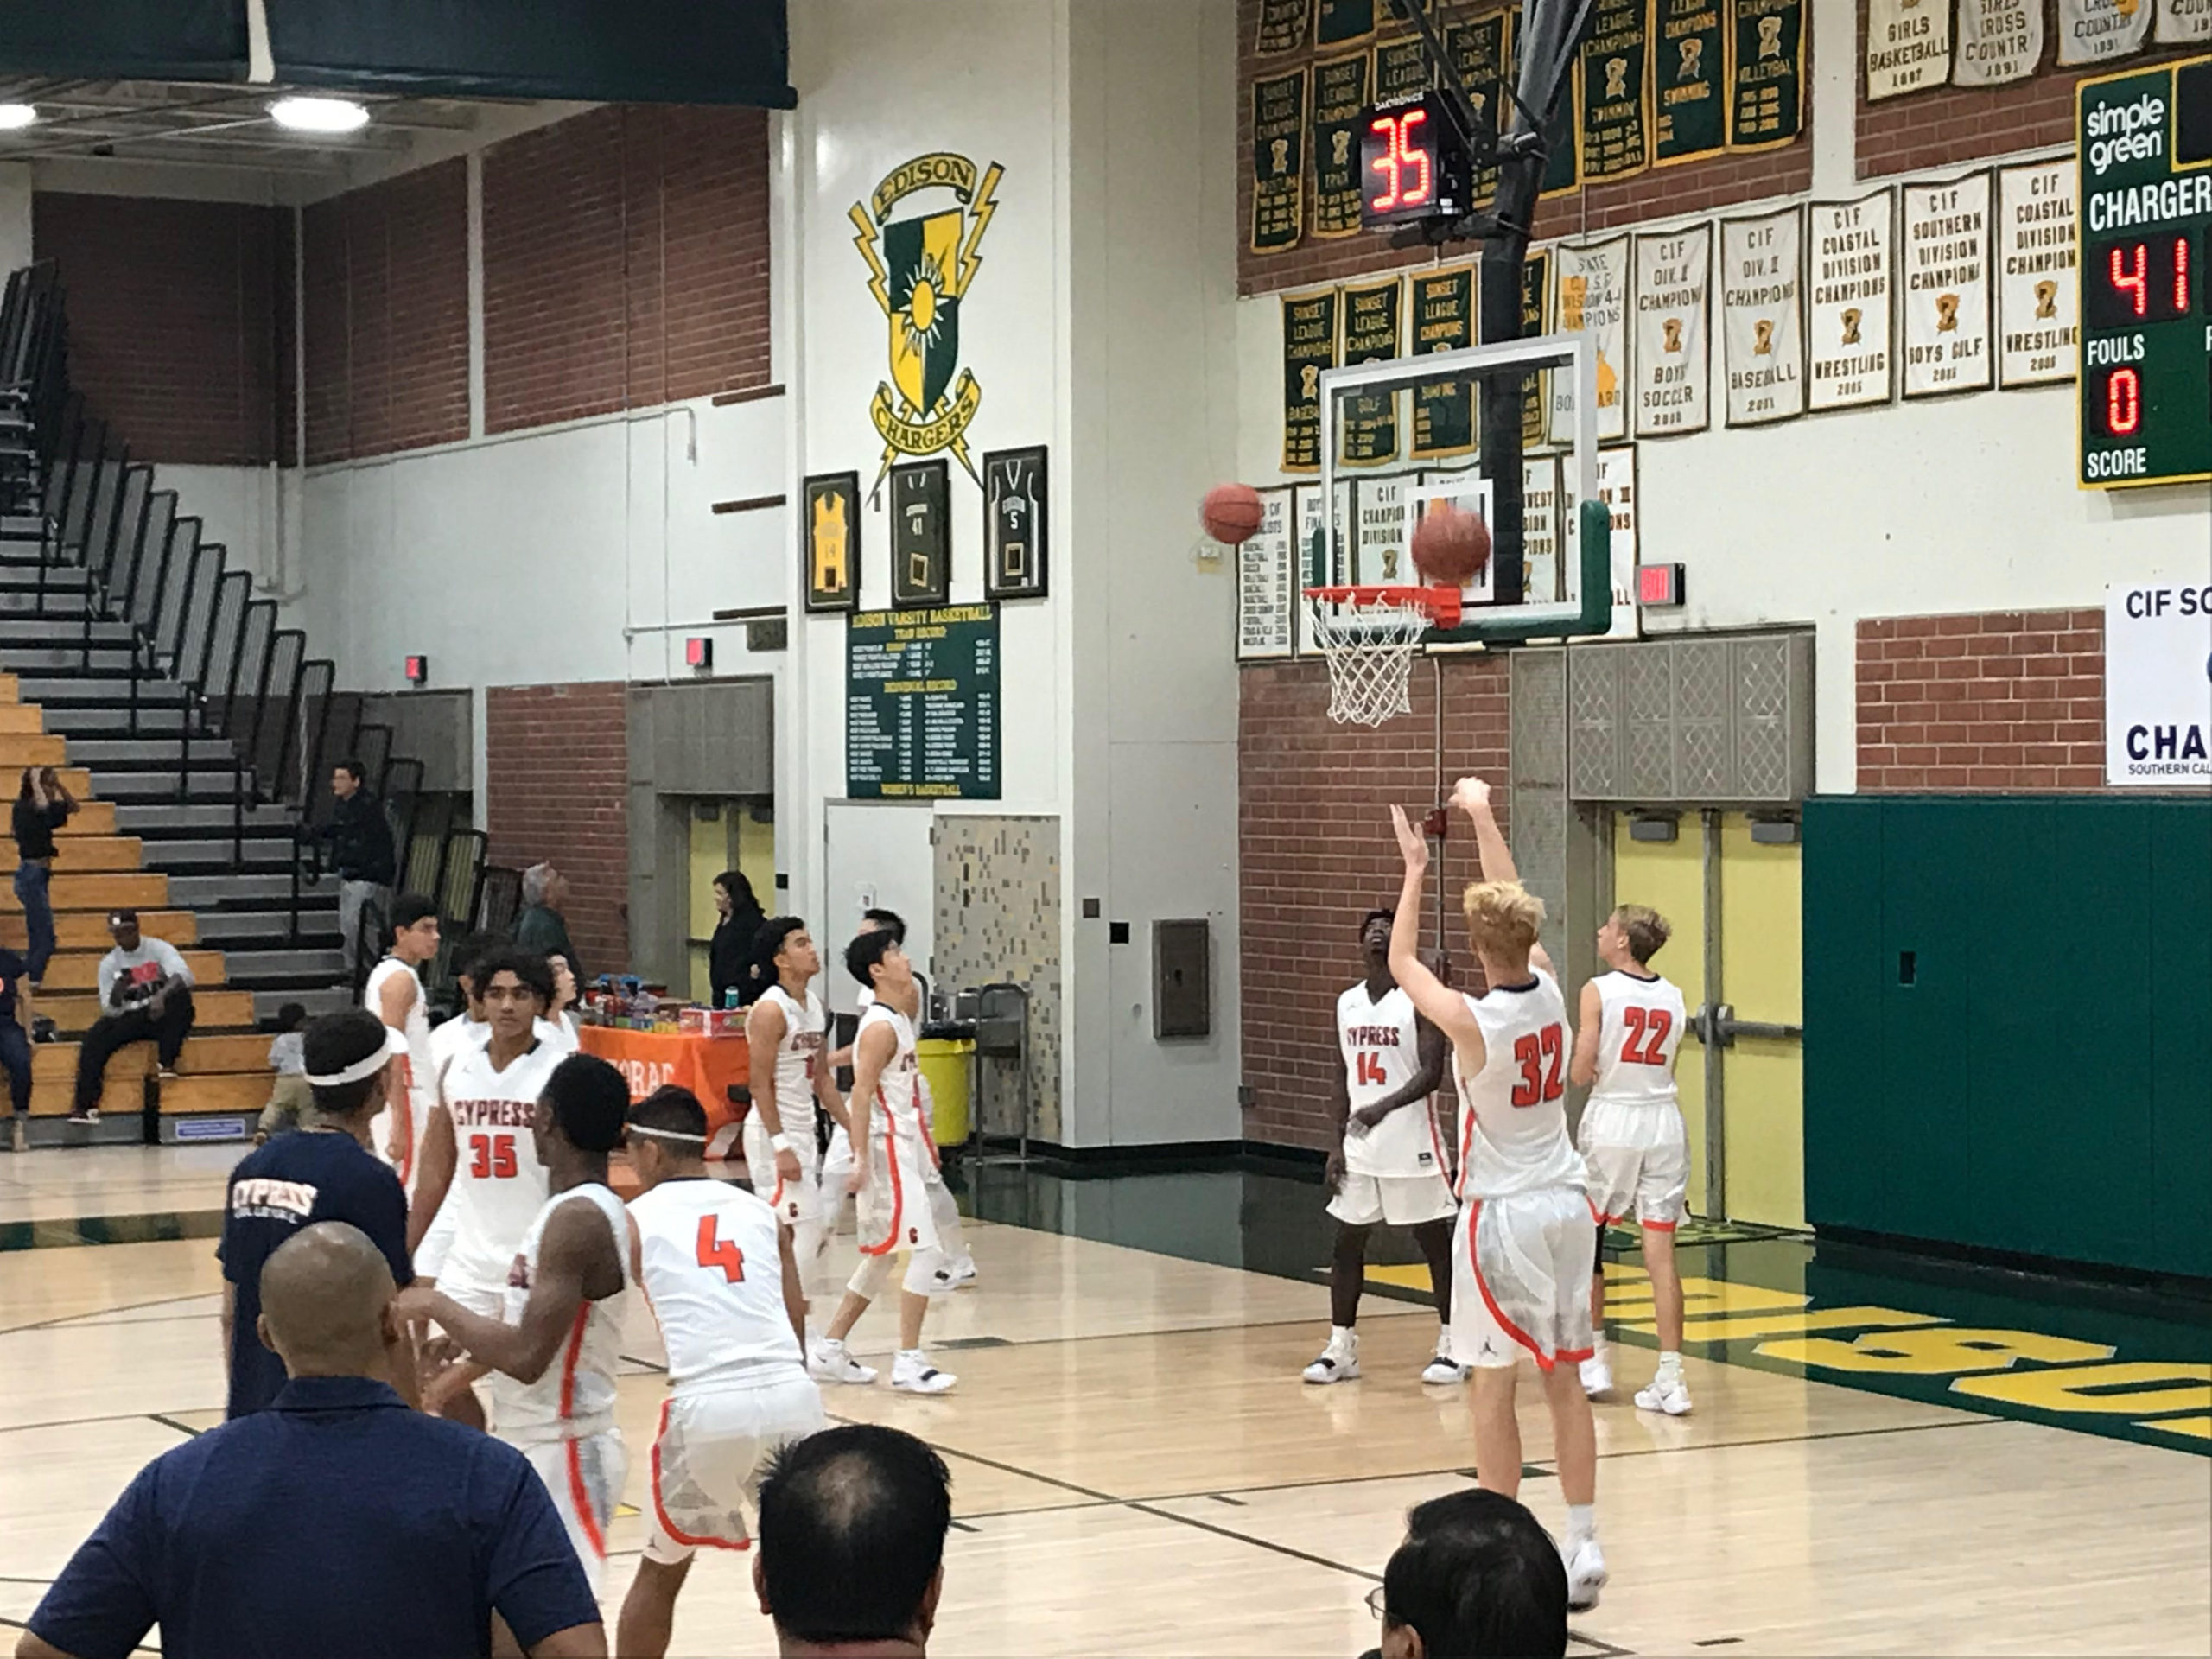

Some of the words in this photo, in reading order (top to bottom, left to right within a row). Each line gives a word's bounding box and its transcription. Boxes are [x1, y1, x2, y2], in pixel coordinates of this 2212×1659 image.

[1888, 16, 1931, 43] GIRLS
[1869, 36, 1949, 73] BASKETBALL
[2087, 92, 2165, 137] simple
[1371, 109, 1430, 210] 35
[2089, 130, 2163, 175] green
[877, 158, 972, 205] EDISON
[2031, 174, 2059, 196] CIF
[1929, 190, 1959, 213] CIF
[2016, 198, 2074, 225] COASTAL
[1834, 207, 1861, 231] CIF
[1912, 211, 1982, 241] SOUTHERN
[1660, 240, 1685, 261] CIF
[1747, 227, 1775, 249] CIF
[1822, 228, 1880, 256] COASTAL
[1918, 238, 1978, 266] DIVISION
[1822, 252, 1882, 280] DIVISION
[1815, 276, 1885, 305] CHAMPIONS
[2087, 334, 2145, 366] FOULS
[1731, 362, 1797, 390] BASEBALL
[1814, 353, 1885, 381] WRESTLING
[1643, 385, 1694, 409] SOCCER
[2106, 365, 2139, 434] 0
[875, 394, 975, 450] CHARGERS
[2088, 447, 2147, 478] SCORE
[1376, 486, 1396, 503] CIF
[1361, 528, 1403, 545] DIVISION
[2126, 589, 2172, 619] CIF
[2128, 762, 2190, 775] SOUTHERN
[1619, 1006, 1673, 1066] 22
[1357, 1051, 1388, 1086] 14
[1511, 1021, 1564, 1108] 32
[454, 1099, 535, 1128] CYPRESS
[470, 1133, 518, 1179] 35
[695, 1212, 746, 1284] 4
